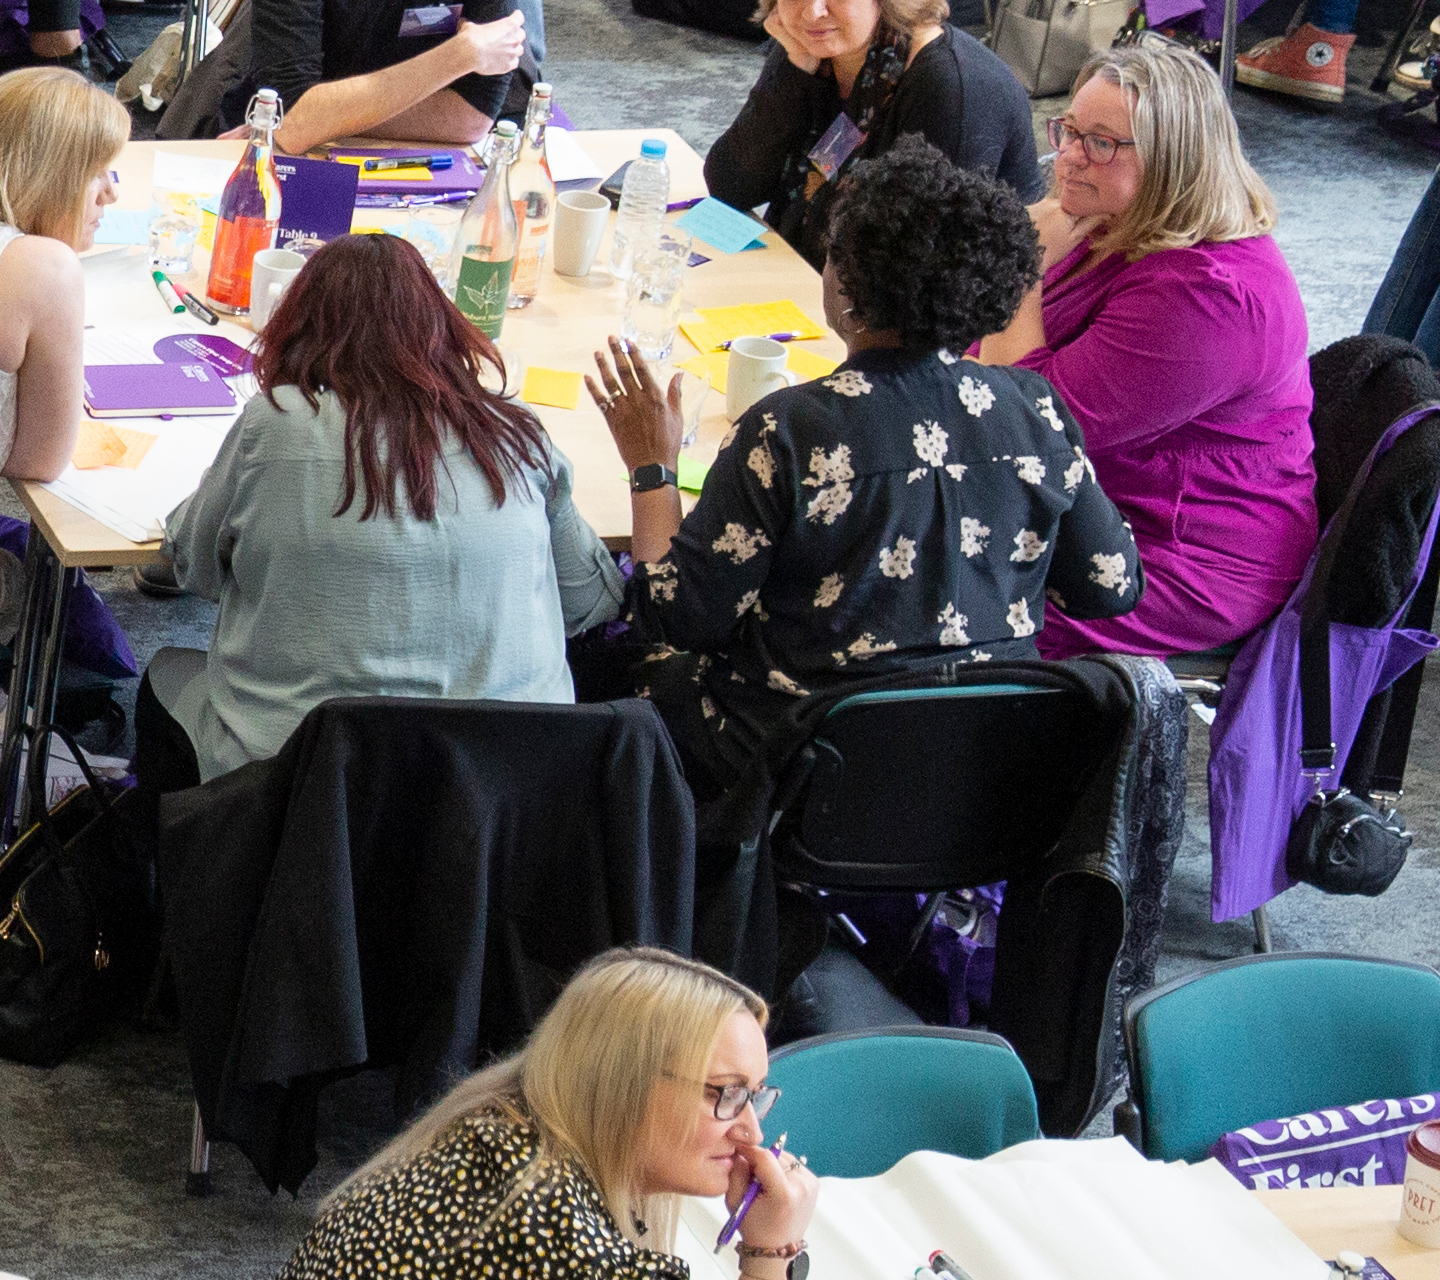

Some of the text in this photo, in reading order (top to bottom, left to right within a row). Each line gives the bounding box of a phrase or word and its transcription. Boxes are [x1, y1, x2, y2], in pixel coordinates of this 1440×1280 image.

[274, 163, 296, 175] arers
[278, 228, 308, 241] Table
[1250, 1154, 1383, 1190] First
[1407, 1188, 1436, 1215] PRET
